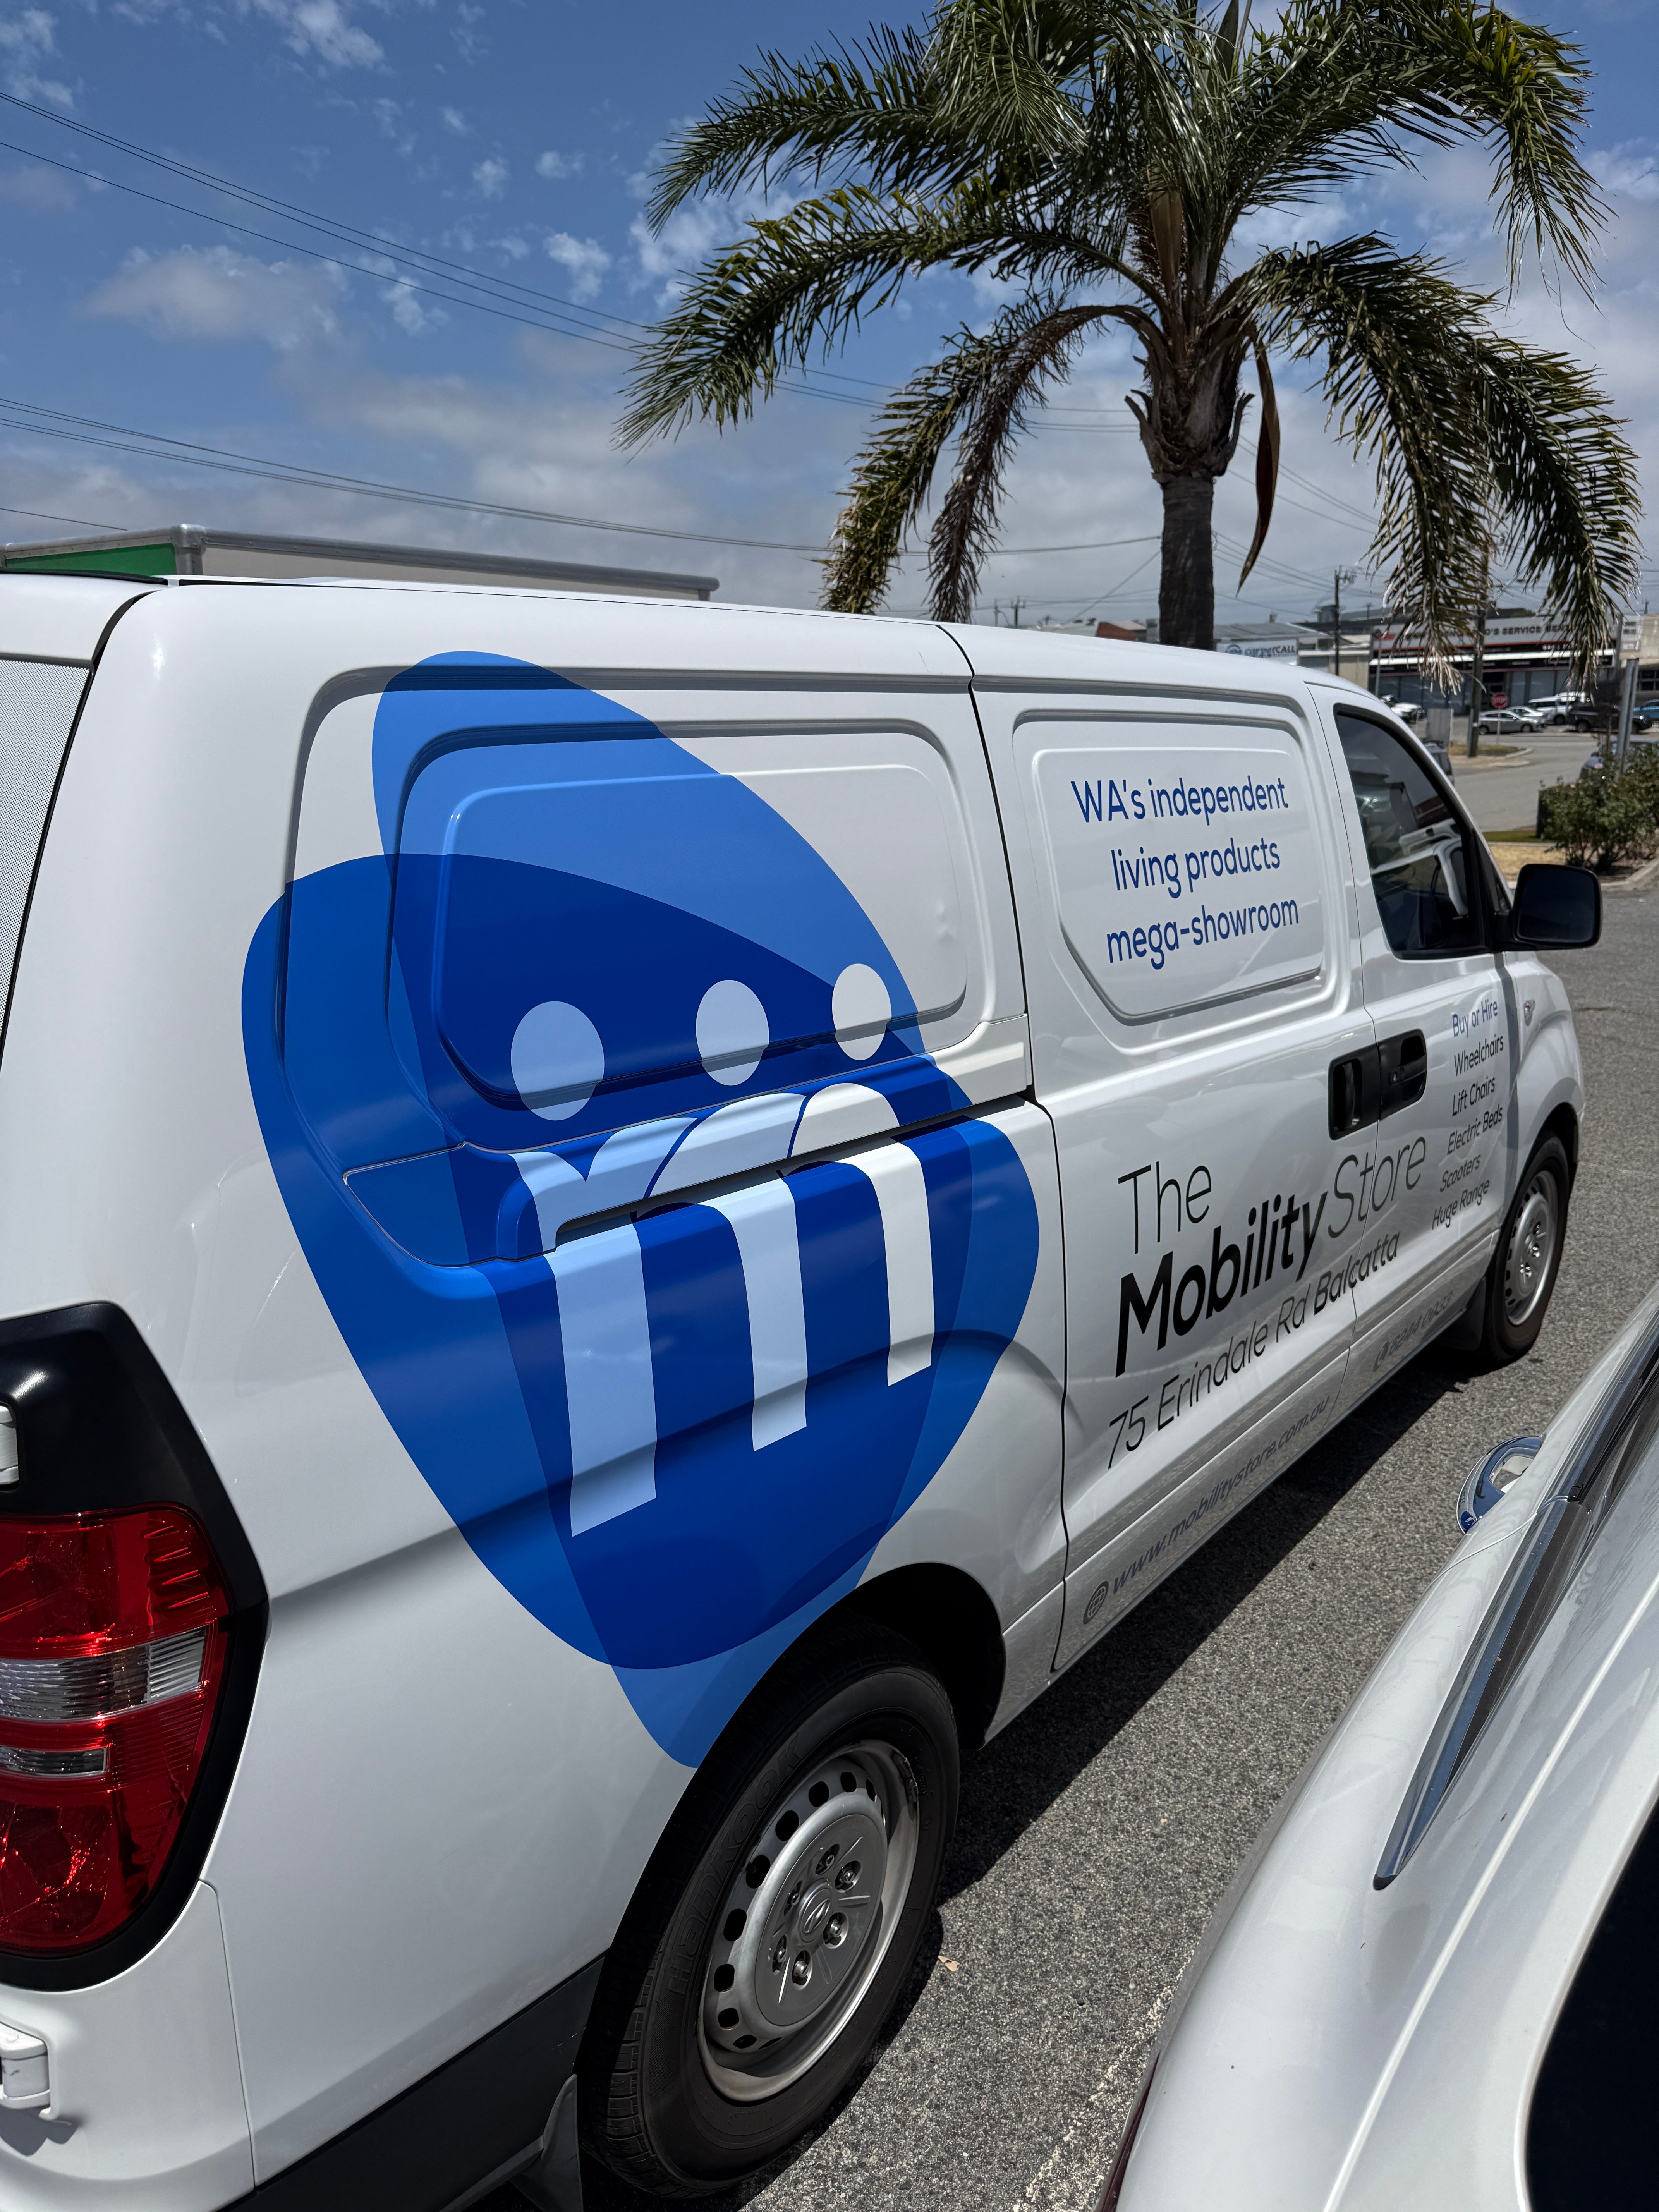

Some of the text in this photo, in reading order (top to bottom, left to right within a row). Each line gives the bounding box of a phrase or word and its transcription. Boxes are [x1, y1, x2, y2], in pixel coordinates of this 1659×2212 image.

[1503, 625, 1541, 635] SERVICE
[1071, 775, 1288, 825] WA's independent
[1111, 838, 1280, 898] living products
[1107, 898, 1299, 969] mega-showroom
[1452, 1000, 1498, 1038] Buy or Hire
[1454, 1035, 1503, 1076] Wheelchairs
[1452, 1077, 1495, 1116] Lift Chairs
[1447, 1105, 1503, 1155] Electric Beds
[1440, 1153, 1481, 1192] Scooters
[1118, 1161, 1211, 1254] The
[1432, 1179, 1489, 1230] Huge Range
[1108, 1231, 1400, 1469] 75 Erindale Rd Balcatta
[1113, 1395, 1329, 1594] www.mobilitystore.com.au
